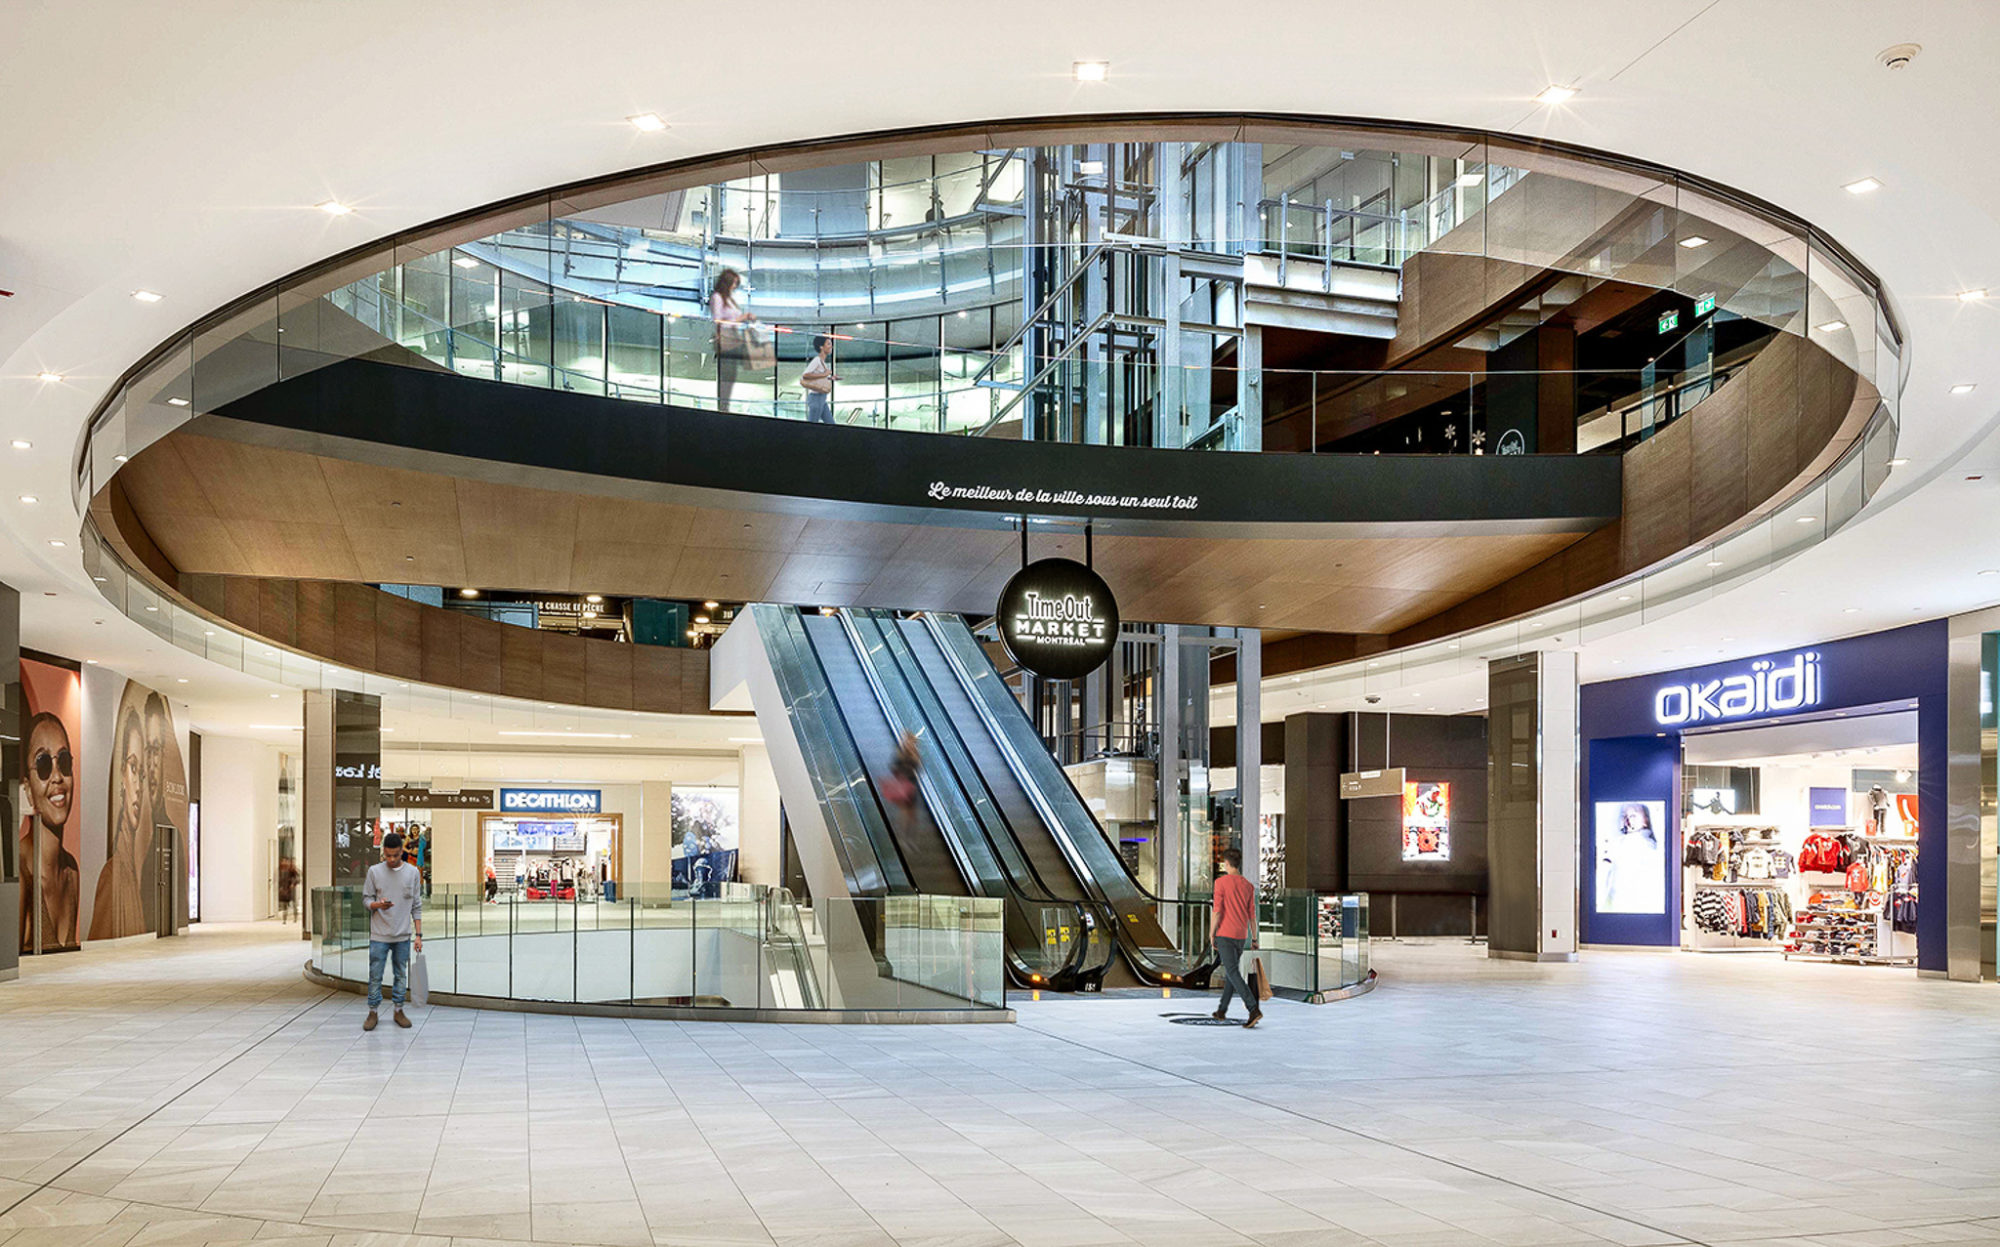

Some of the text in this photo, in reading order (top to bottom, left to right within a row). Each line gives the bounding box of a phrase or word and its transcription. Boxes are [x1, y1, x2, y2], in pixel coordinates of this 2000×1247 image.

[928, 481, 1199, 509] Le meilleur de la ville sous un seul toit
[1016, 620, 1104, 637] MARKET
